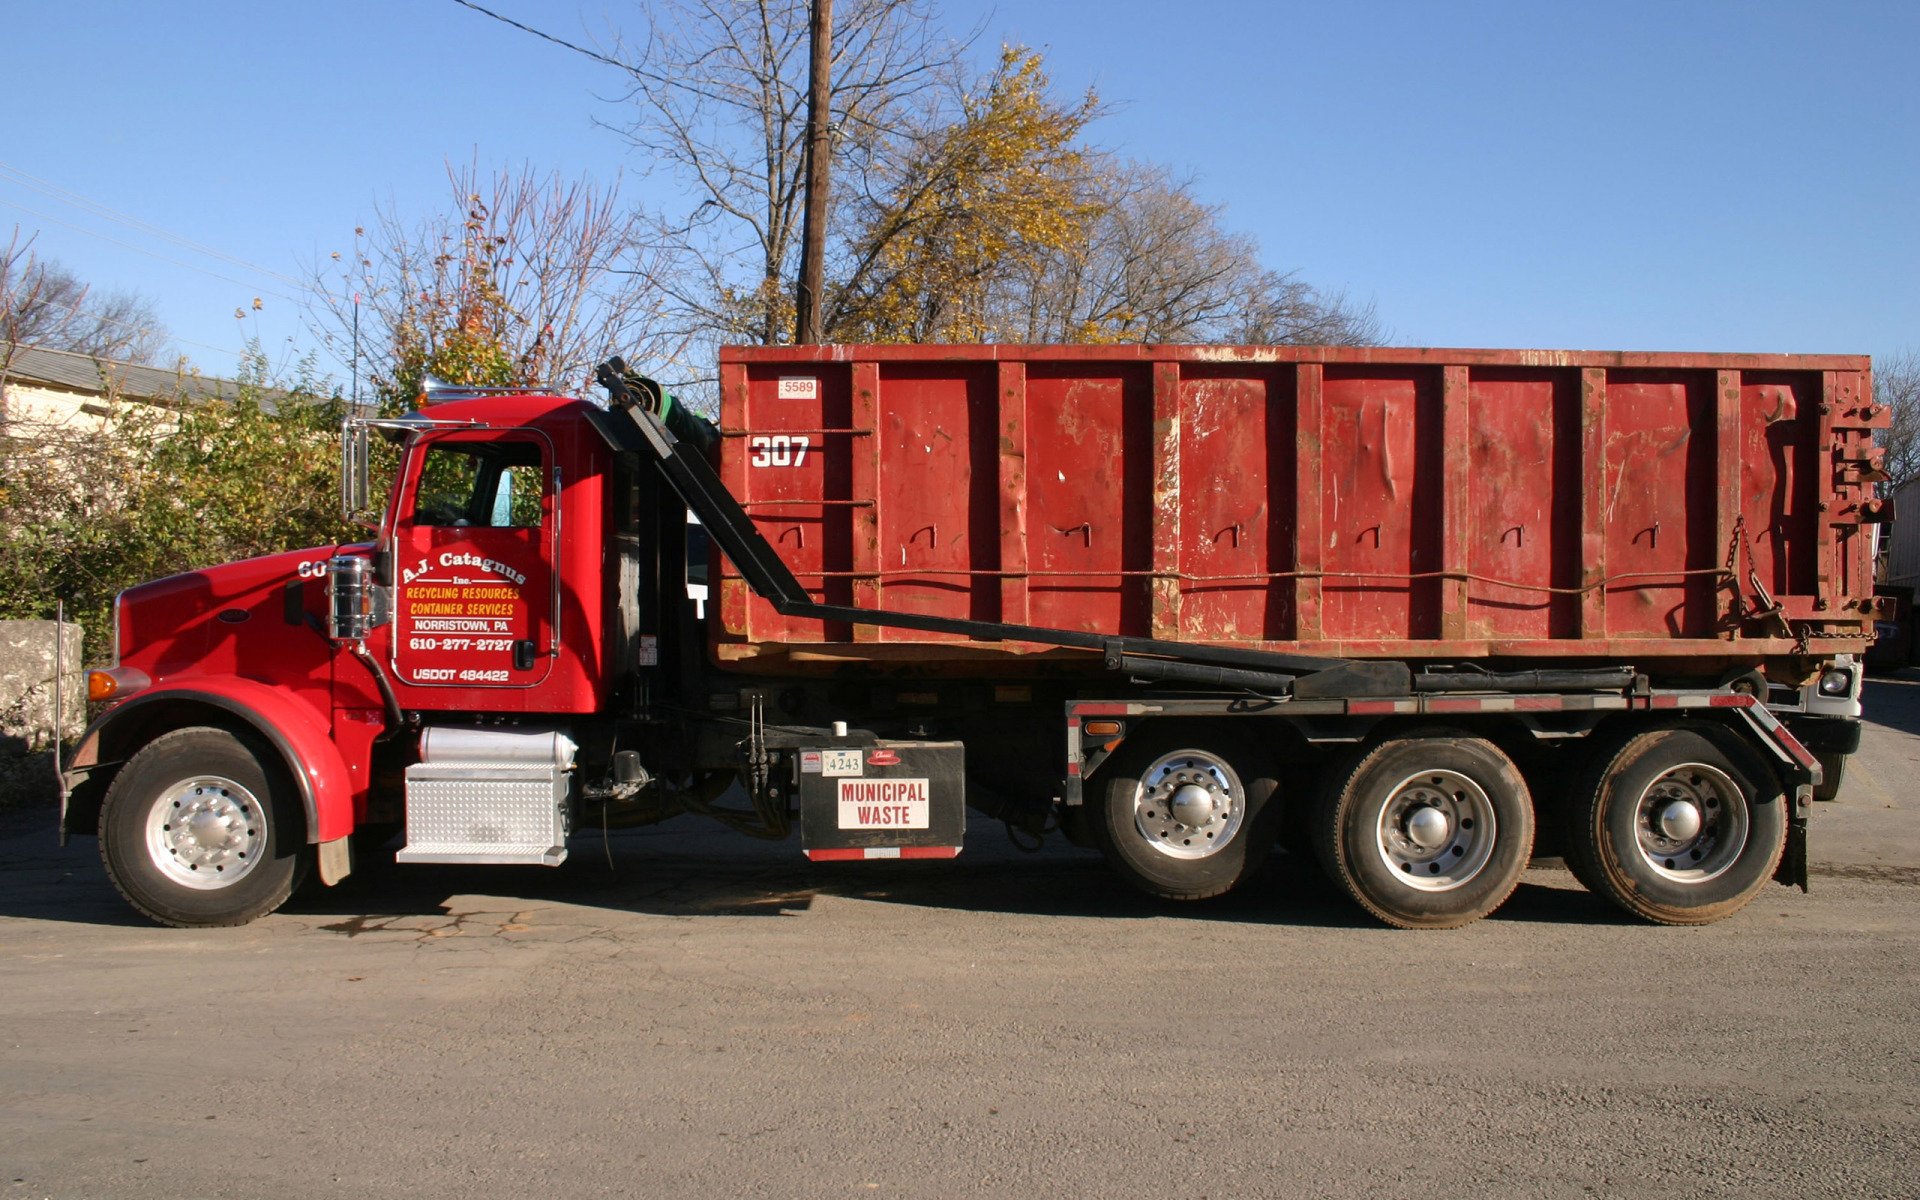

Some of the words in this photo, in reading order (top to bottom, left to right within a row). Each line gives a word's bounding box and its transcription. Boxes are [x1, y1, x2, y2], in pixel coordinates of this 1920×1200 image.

[785, 381, 813, 392] 5589
[752, 435, 809, 467] 307
[402, 559, 434, 584] A.J.
[439, 552, 526, 585] Catagnus
[453, 576, 472, 585] Inc.
[406, 587, 459, 599] RECYCLING
[461, 588, 520, 600] RESOURCES
[410, 603, 463, 615] CONTAINER
[466, 604, 513, 615] SERVICES
[415, 620, 490, 632] NORRISTOWN,
[494, 621, 508, 631] PA
[409, 638, 514, 651] 610-277-2727
[413, 669, 456, 680] USDOT
[459, 670, 509, 681] 484422
[829, 758, 859, 770] 4243
[841, 783, 926, 801] MUNICIPAL
[857, 806, 910, 824] WASTE
